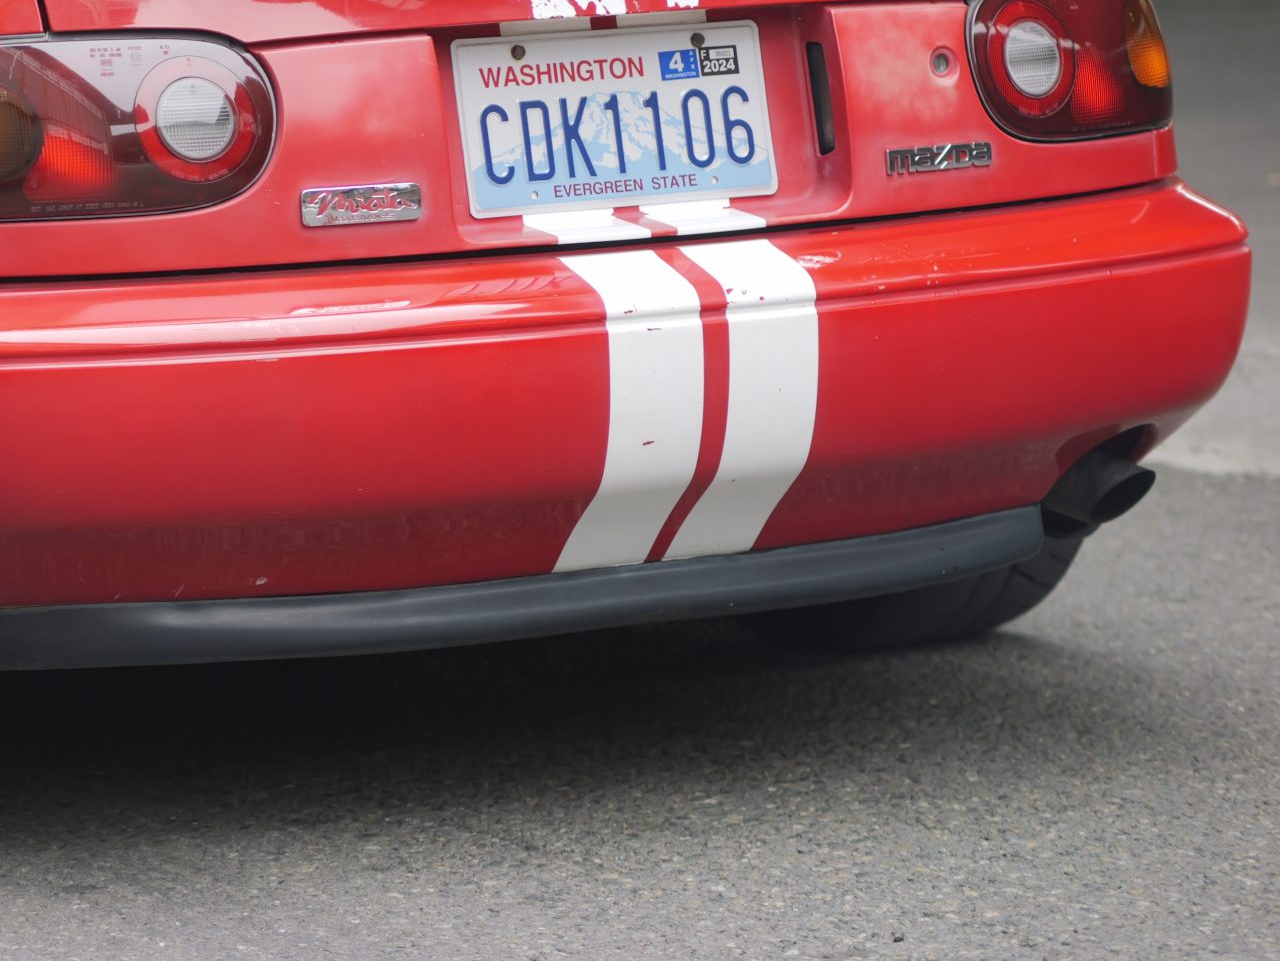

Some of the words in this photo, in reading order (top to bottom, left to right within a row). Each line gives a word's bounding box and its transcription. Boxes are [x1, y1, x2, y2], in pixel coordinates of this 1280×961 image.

[478, 55, 645, 89] WASHINGTON
[669, 51, 685, 72] 4
[703, 58, 736, 73] 2024
[479, 85, 756, 186] CDK1106
[553, 178, 644, 199] EVERGREEN
[651, 173, 699, 191] STATE
